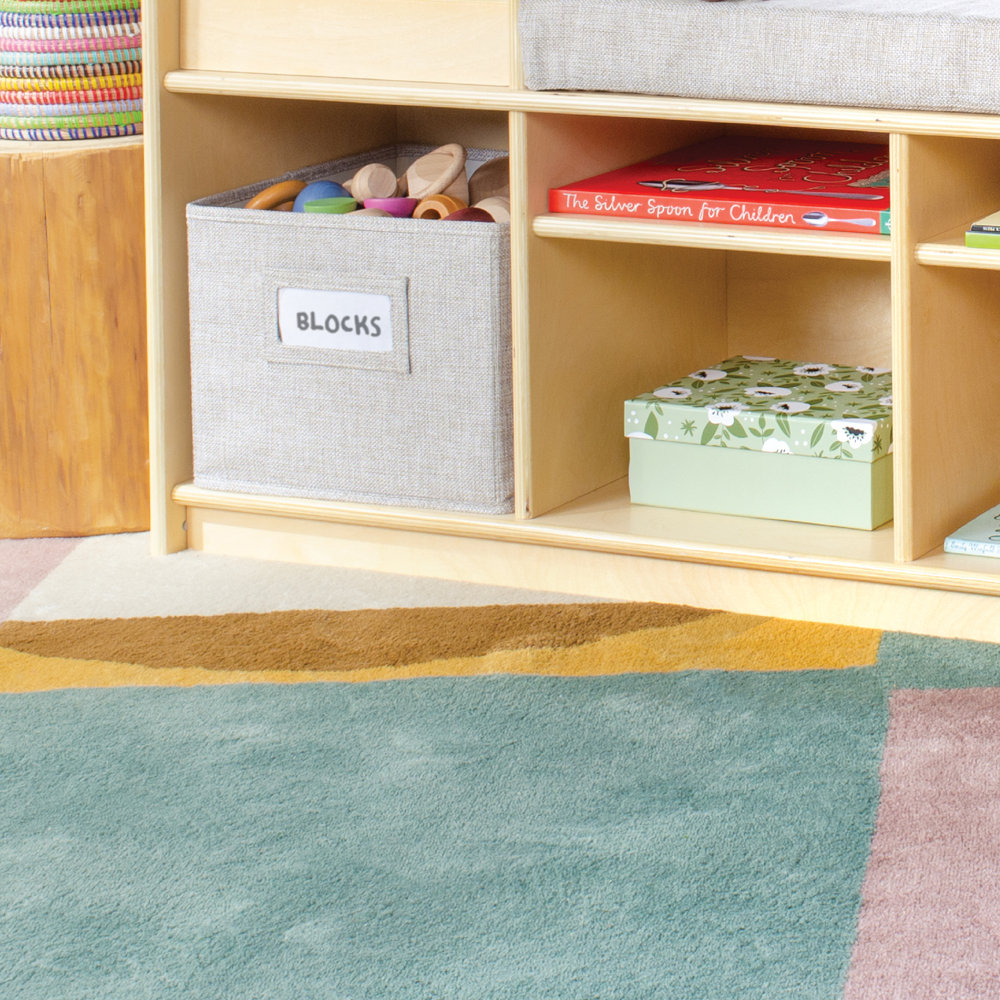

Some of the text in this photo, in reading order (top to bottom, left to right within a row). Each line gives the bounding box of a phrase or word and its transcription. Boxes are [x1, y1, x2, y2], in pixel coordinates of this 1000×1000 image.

[563, 192, 796, 224] The Silver Spoon for Children
[296, 311, 382, 337] BLOCKS
